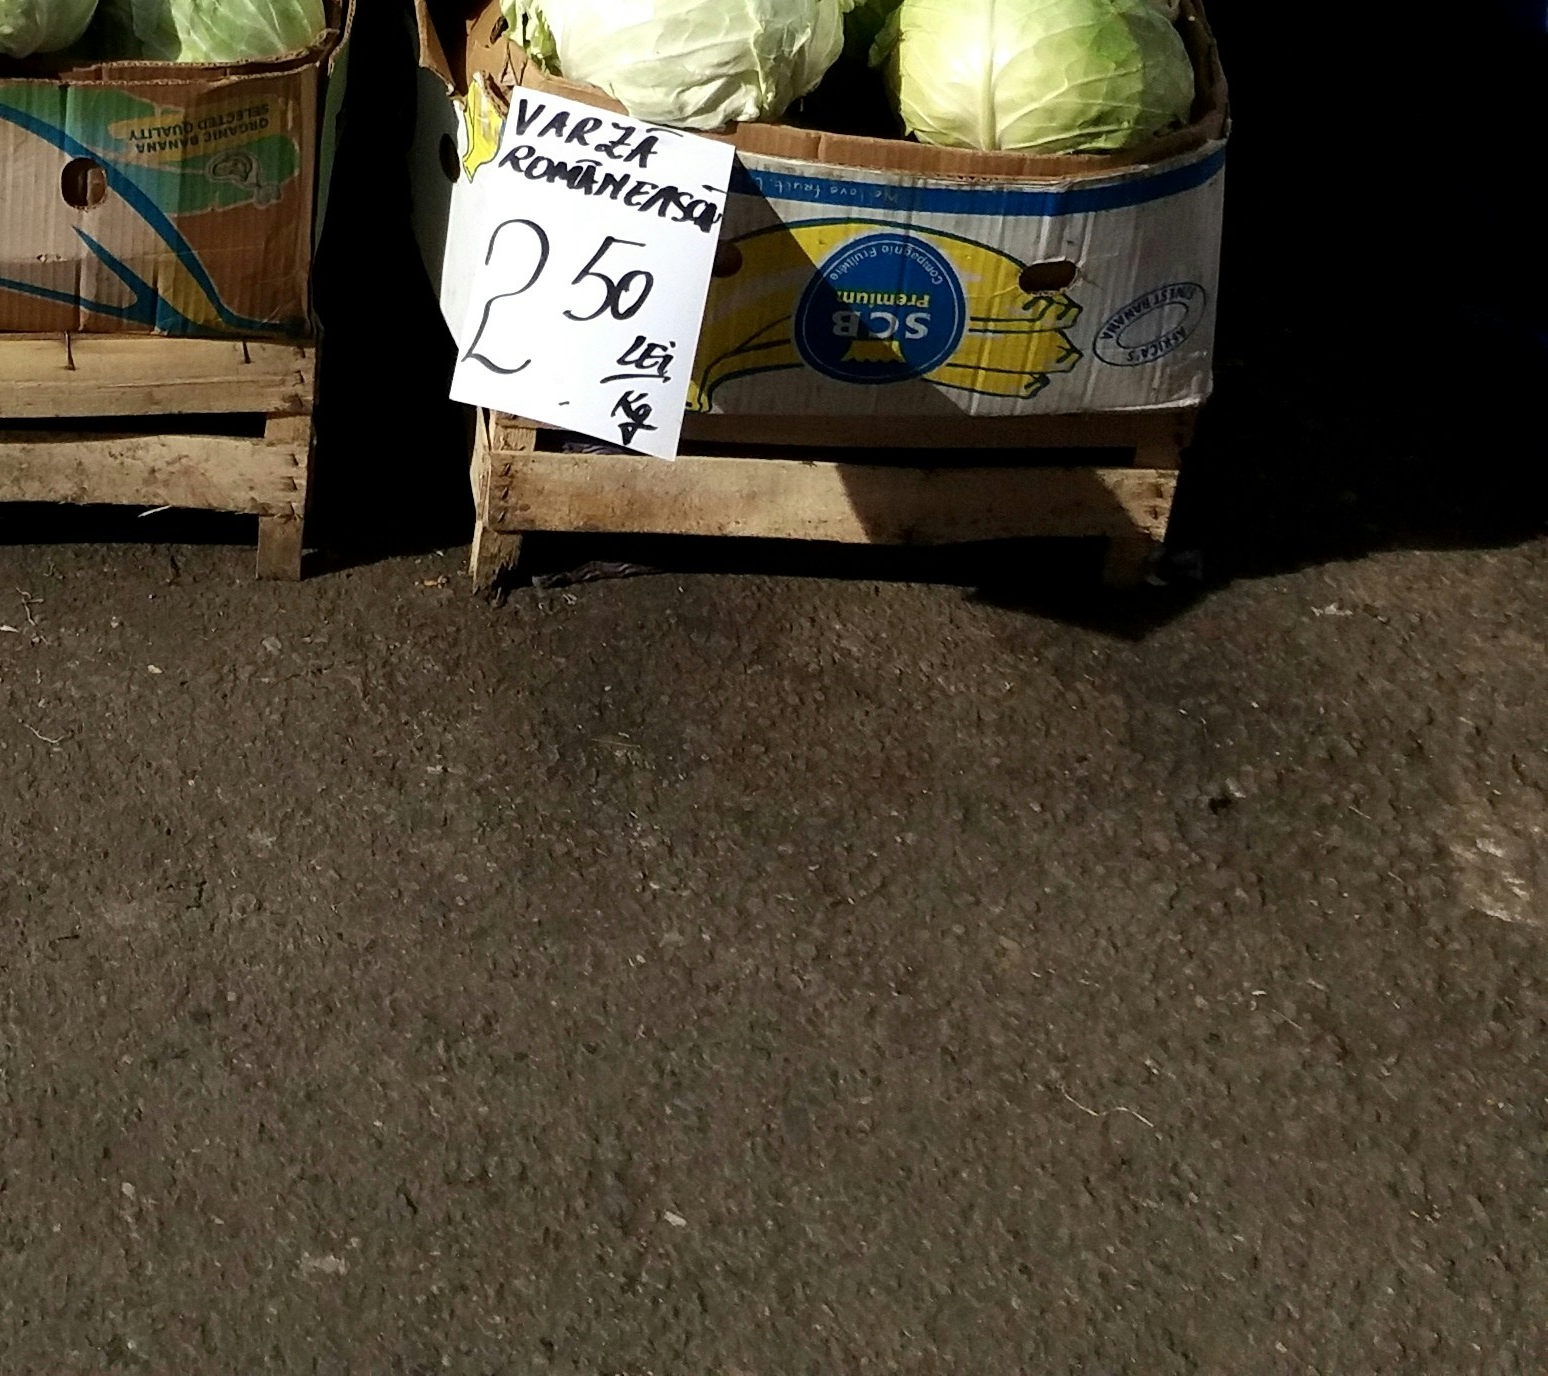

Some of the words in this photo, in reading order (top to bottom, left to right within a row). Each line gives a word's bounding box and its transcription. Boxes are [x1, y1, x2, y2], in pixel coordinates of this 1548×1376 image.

[197, 103, 270, 130] SELECTED
[128, 120, 194, 141] QUALITY
[203, 117, 270, 143] ORGANIC
[136, 134, 199, 154] BANANA
[831, 310, 932, 340] SCB
